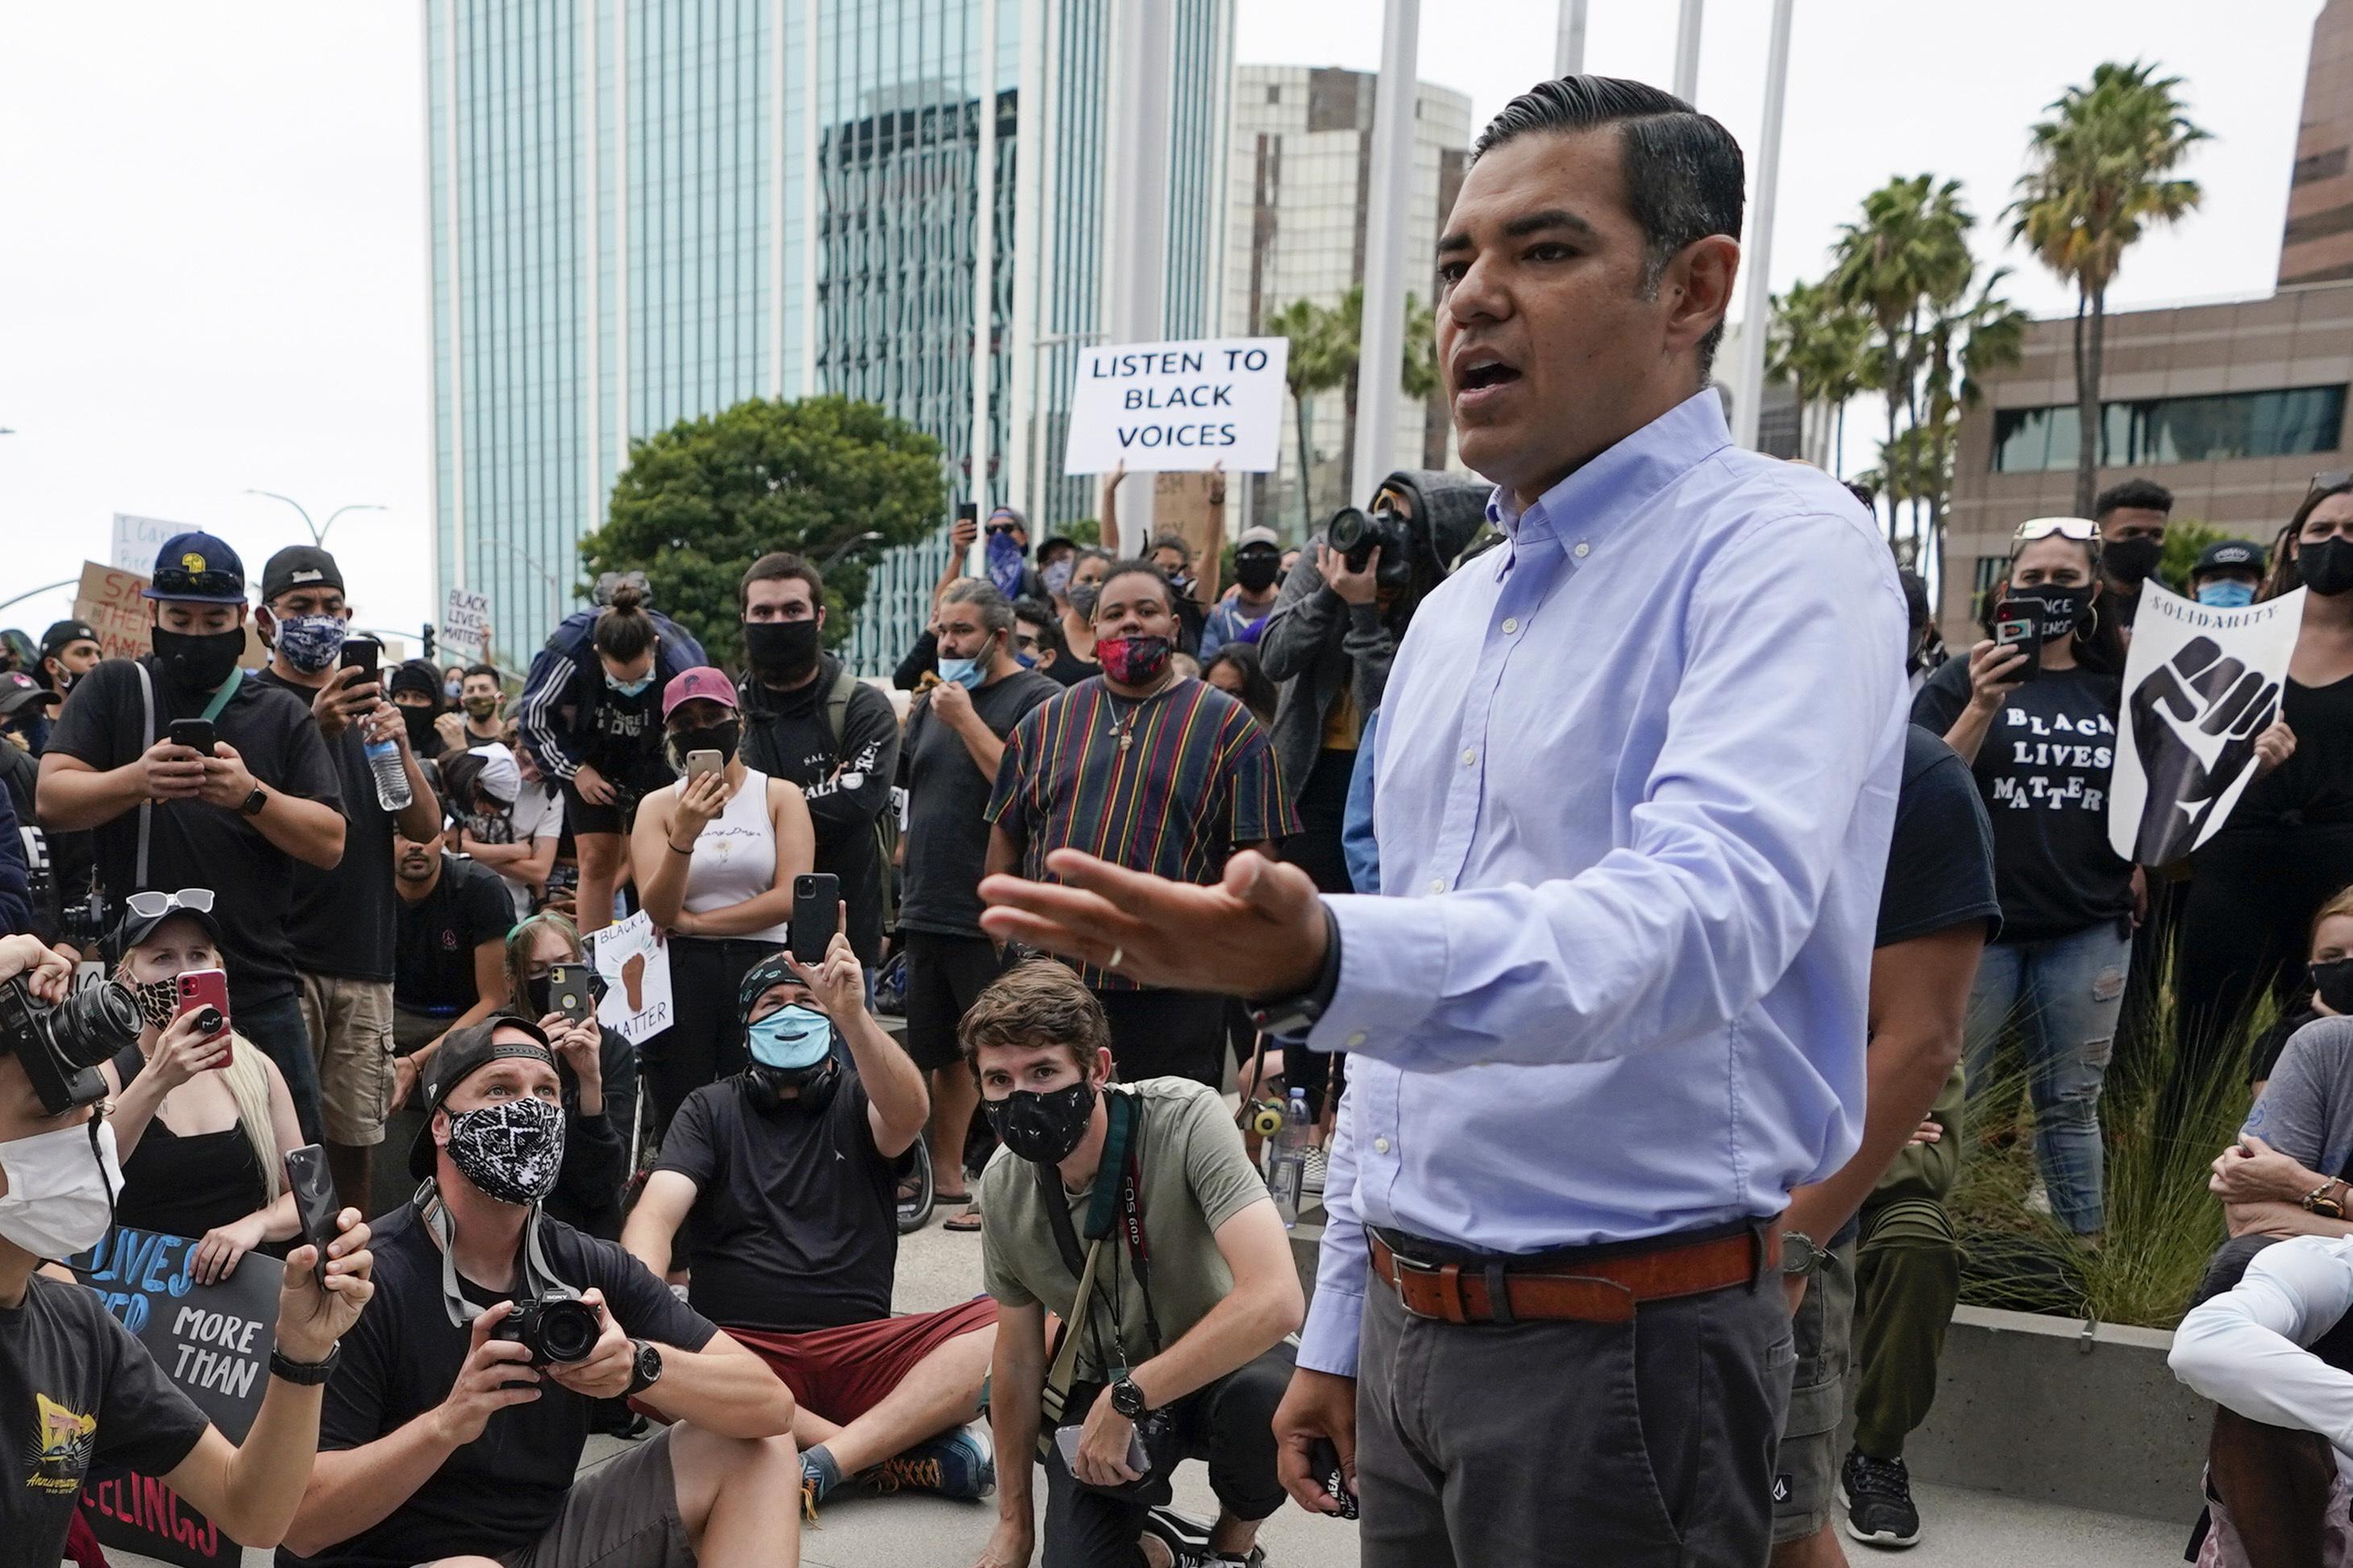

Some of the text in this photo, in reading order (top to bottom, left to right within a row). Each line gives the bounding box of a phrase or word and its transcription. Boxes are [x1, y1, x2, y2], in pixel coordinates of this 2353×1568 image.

[1093, 348, 1268, 378] LISTEN TO
[1125, 385, 1233, 410] BLACK
[1117, 423, 1237, 447] VOICES
[105, 573, 142, 606] SA
[449, 589, 488, 613] BLACK
[448, 609, 484, 629] LIVES
[2006, 708, 2115, 736] BLACK
[2013, 742, 2112, 769] LIVES
[1993, 776, 2103, 811] MATTER
[600, 919, 637, 944] BLACK
[1129, 1217, 1140, 1245] 60D
[172, 1306, 264, 1354] MORE
[174, 1343, 259, 1398] THAN
